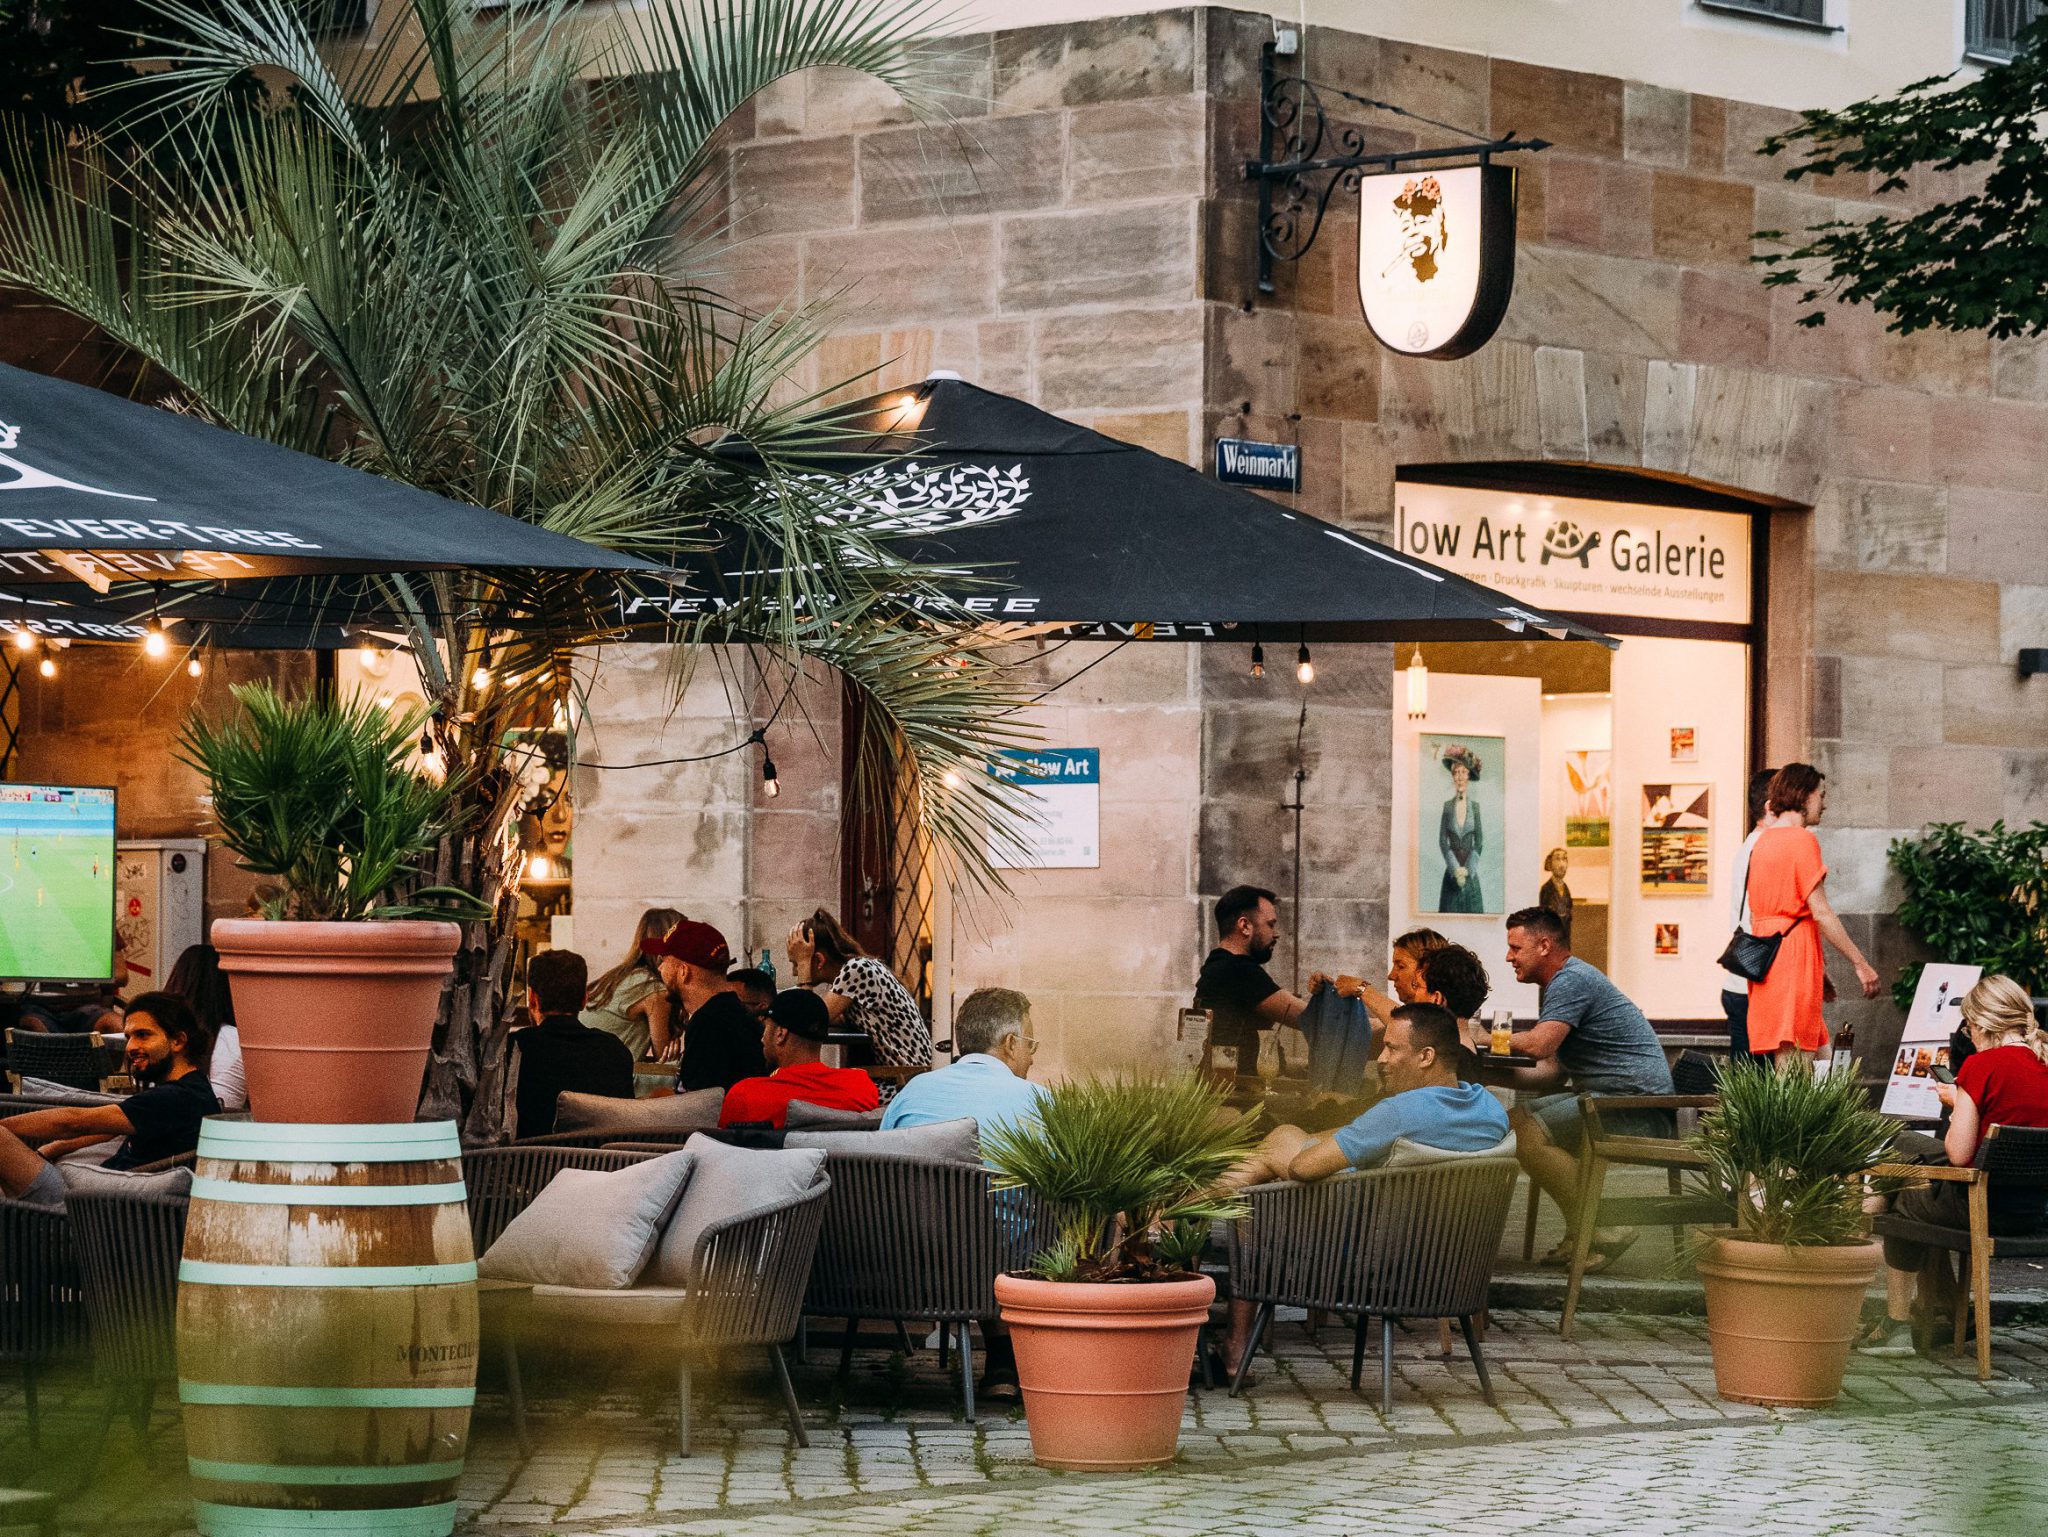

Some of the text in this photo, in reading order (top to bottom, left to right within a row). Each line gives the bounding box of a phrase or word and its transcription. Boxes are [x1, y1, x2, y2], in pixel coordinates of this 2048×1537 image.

[1223, 444, 1296, 479] Weinmarkt
[1472, 516, 1527, 563] Art
[1610, 528, 1726, 580] Galerie
[1494, 571, 1546, 589] Druckgrafik
[1553, 576, 1603, 593] Skulpturen
[1609, 582, 1662, 598] wechselnde
[1664, 586, 1725, 604] Ausstellungen
[1064, 757, 1090, 776] Art
